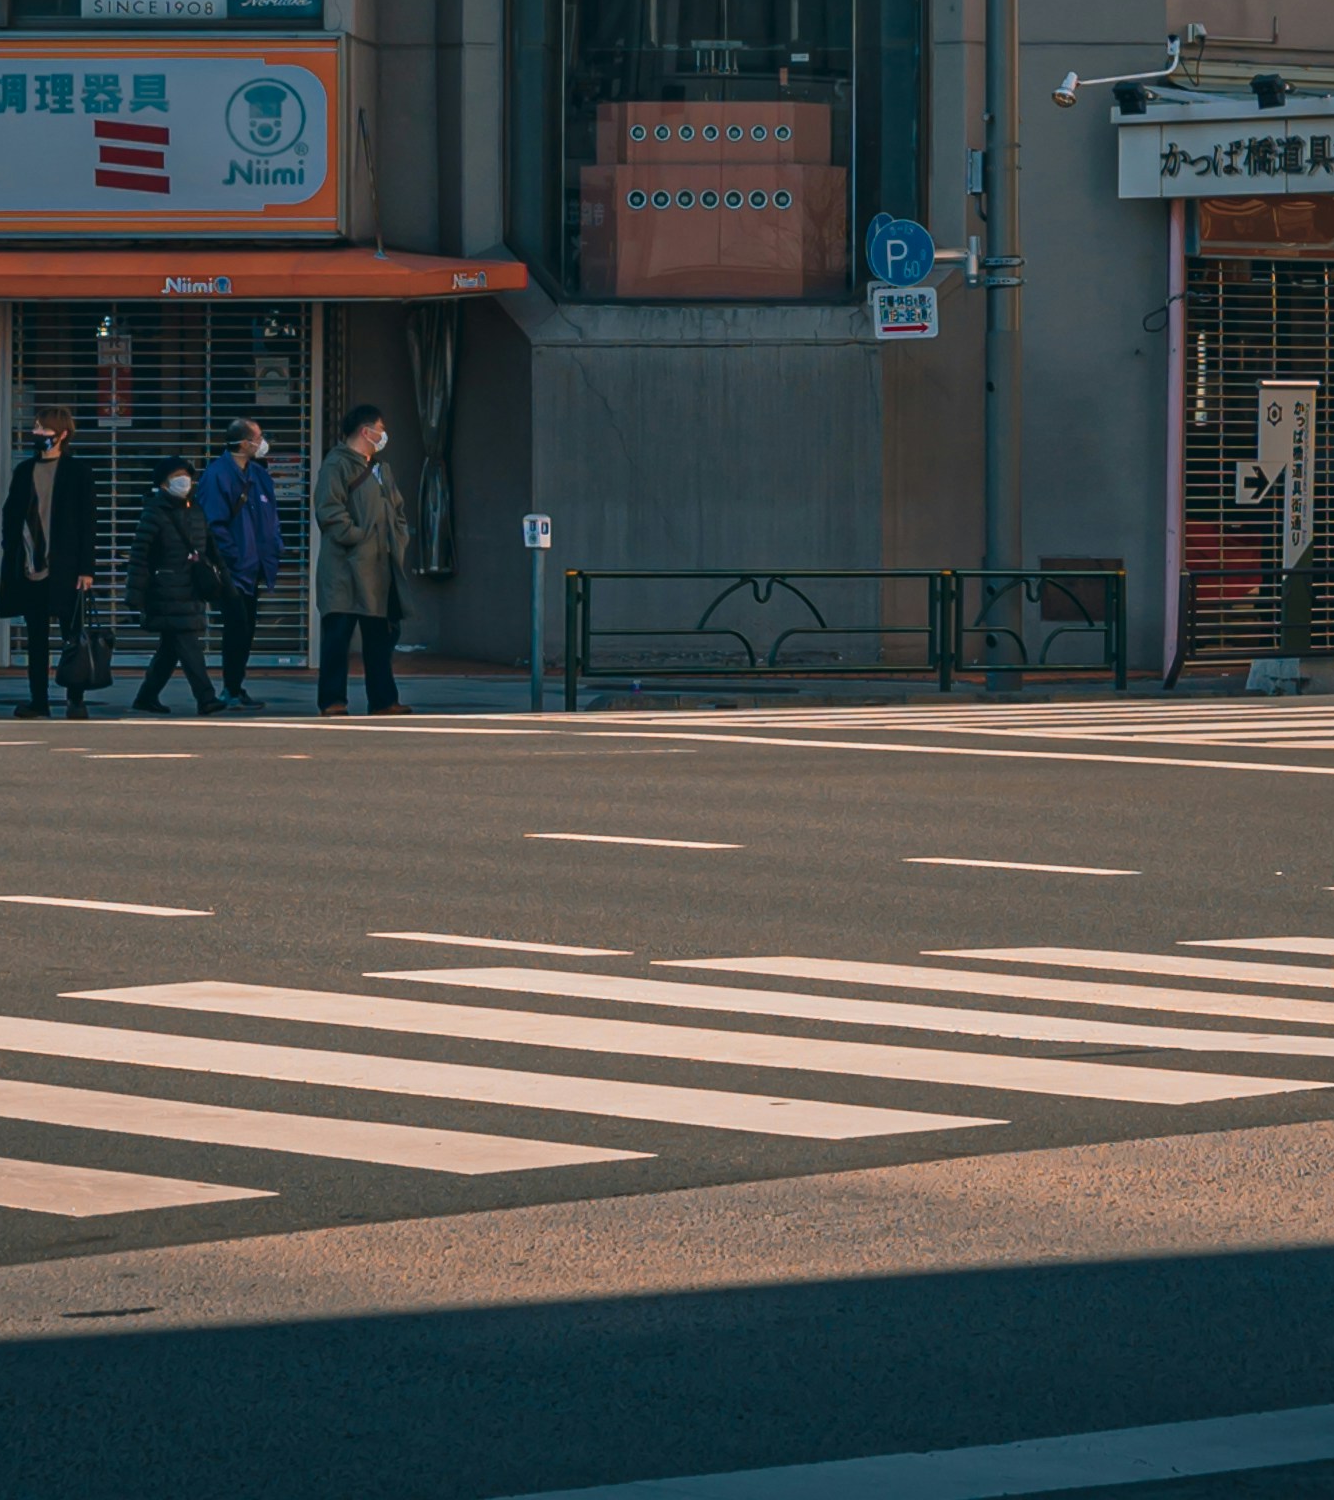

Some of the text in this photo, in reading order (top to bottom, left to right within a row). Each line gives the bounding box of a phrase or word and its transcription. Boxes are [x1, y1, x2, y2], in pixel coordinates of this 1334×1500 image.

[94, 0, 214, 16] SINCE 1908
[222, 159, 305, 186] Niimi
[887, 239, 908, 278] P
[161, 276, 214, 294] Niimi
